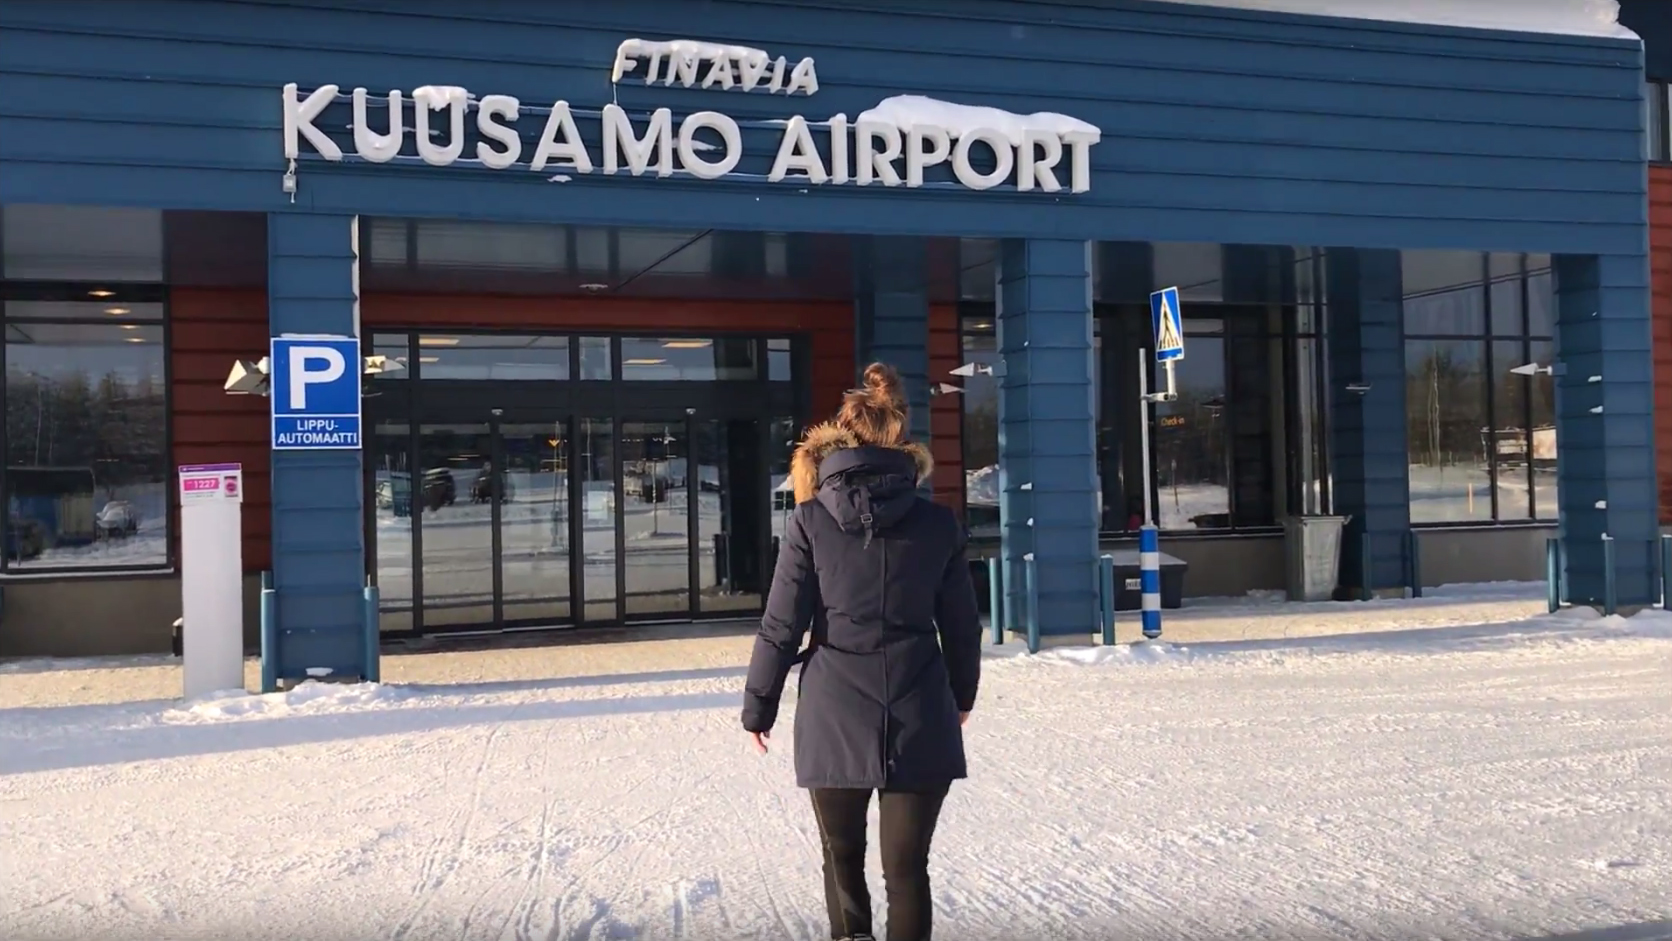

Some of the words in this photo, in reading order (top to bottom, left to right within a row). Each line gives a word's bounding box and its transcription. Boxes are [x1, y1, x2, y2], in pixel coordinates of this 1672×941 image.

[612, 40, 819, 95] FINAVIA
[283, 83, 742, 179] KUUSAMO
[768, 112, 1101, 194] AIRPORT
[289, 346, 346, 409] P
[278, 432, 357, 444] AUTOMAATTI
[297, 420, 339, 431] LIPPU-
[194, 479, 216, 489] 1227
